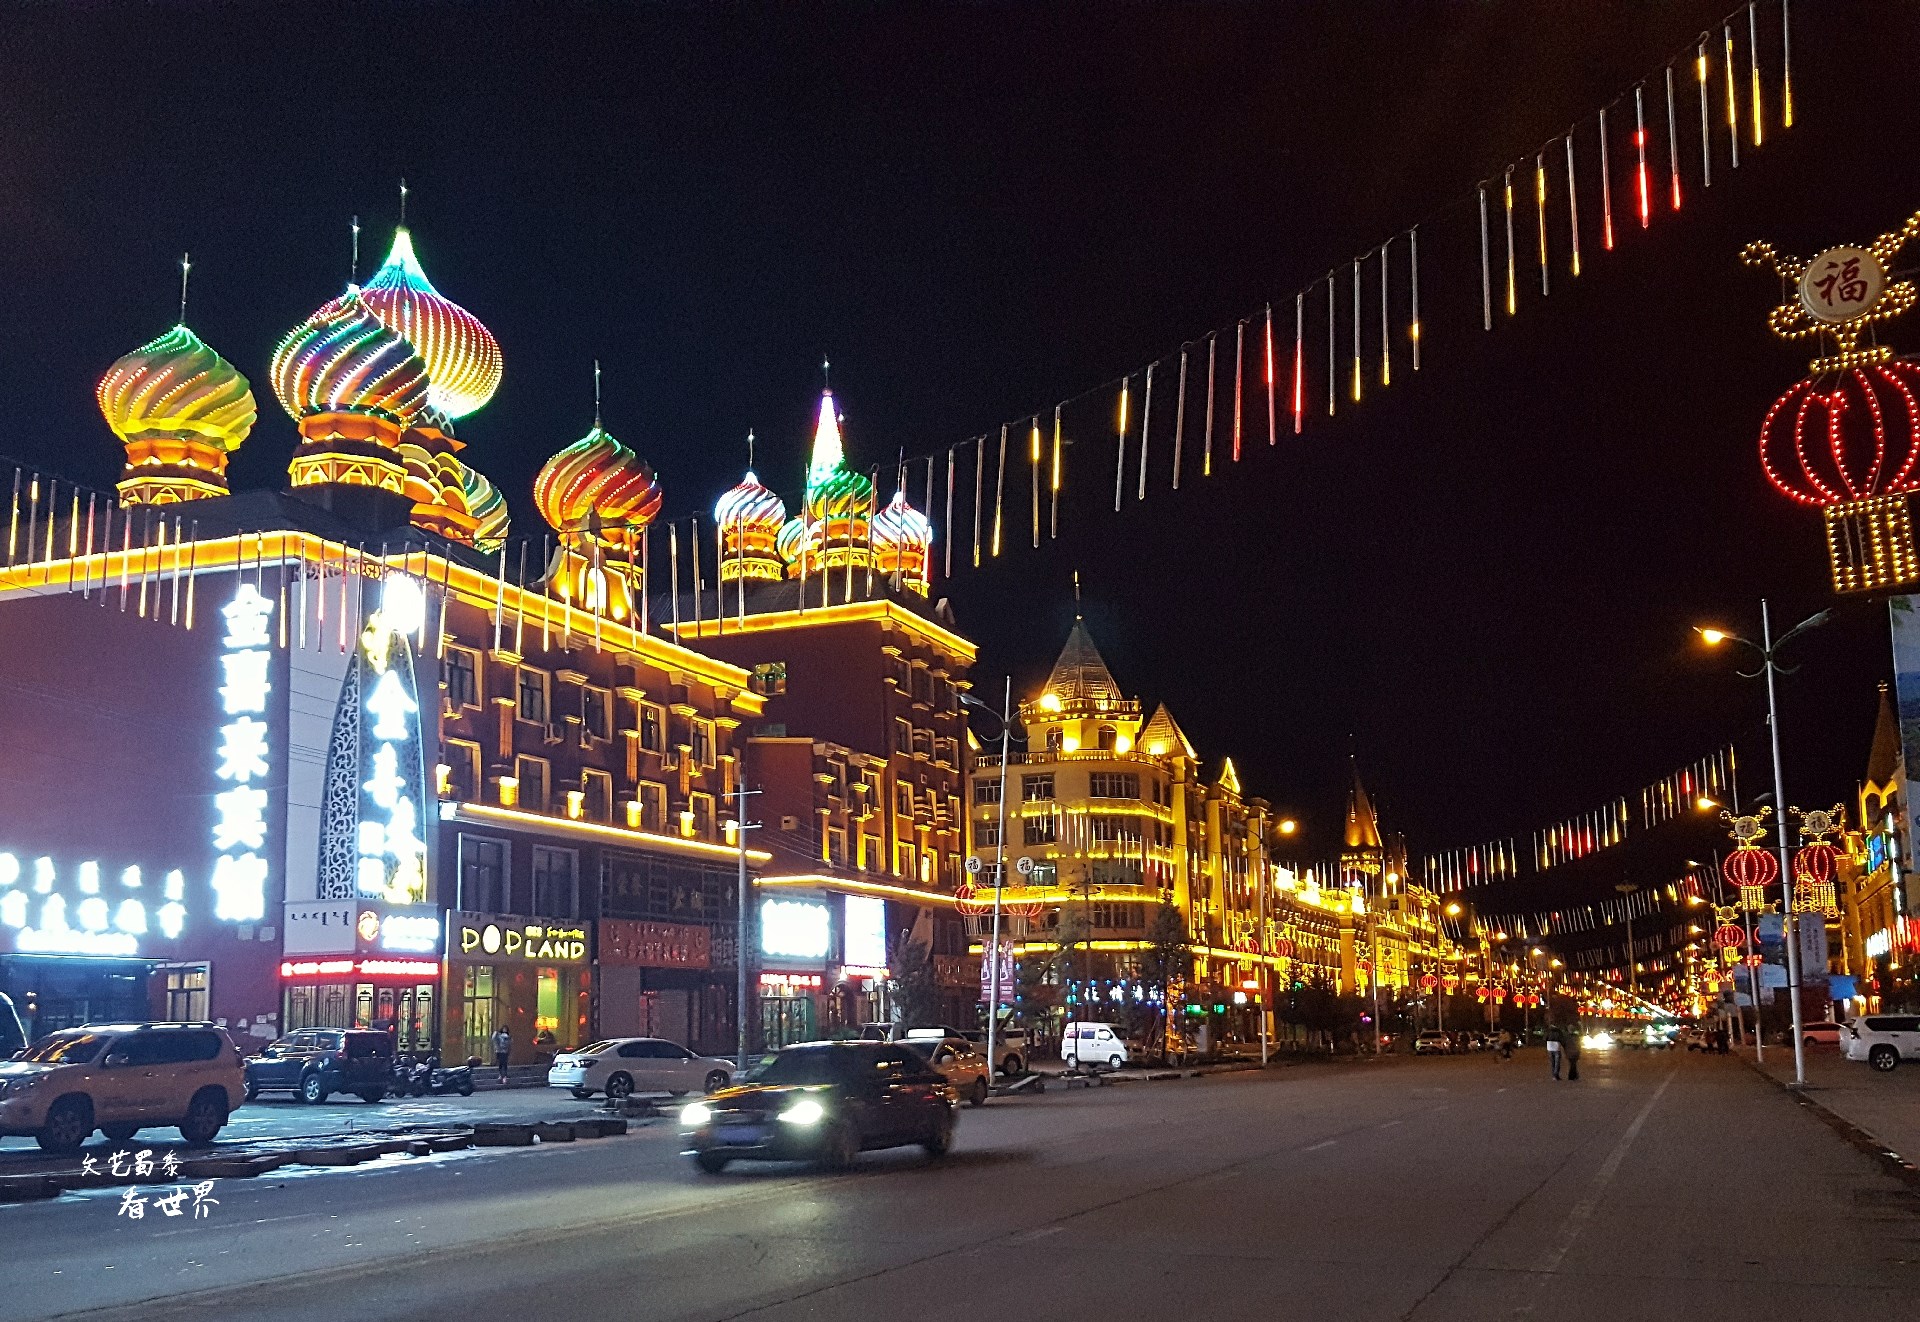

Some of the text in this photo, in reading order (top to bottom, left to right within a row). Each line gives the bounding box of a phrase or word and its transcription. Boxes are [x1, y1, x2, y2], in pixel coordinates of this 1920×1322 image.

[1812, 256, 1868, 307] 福
[461, 924, 522, 955] POP
[524, 939, 585, 959] LAND
